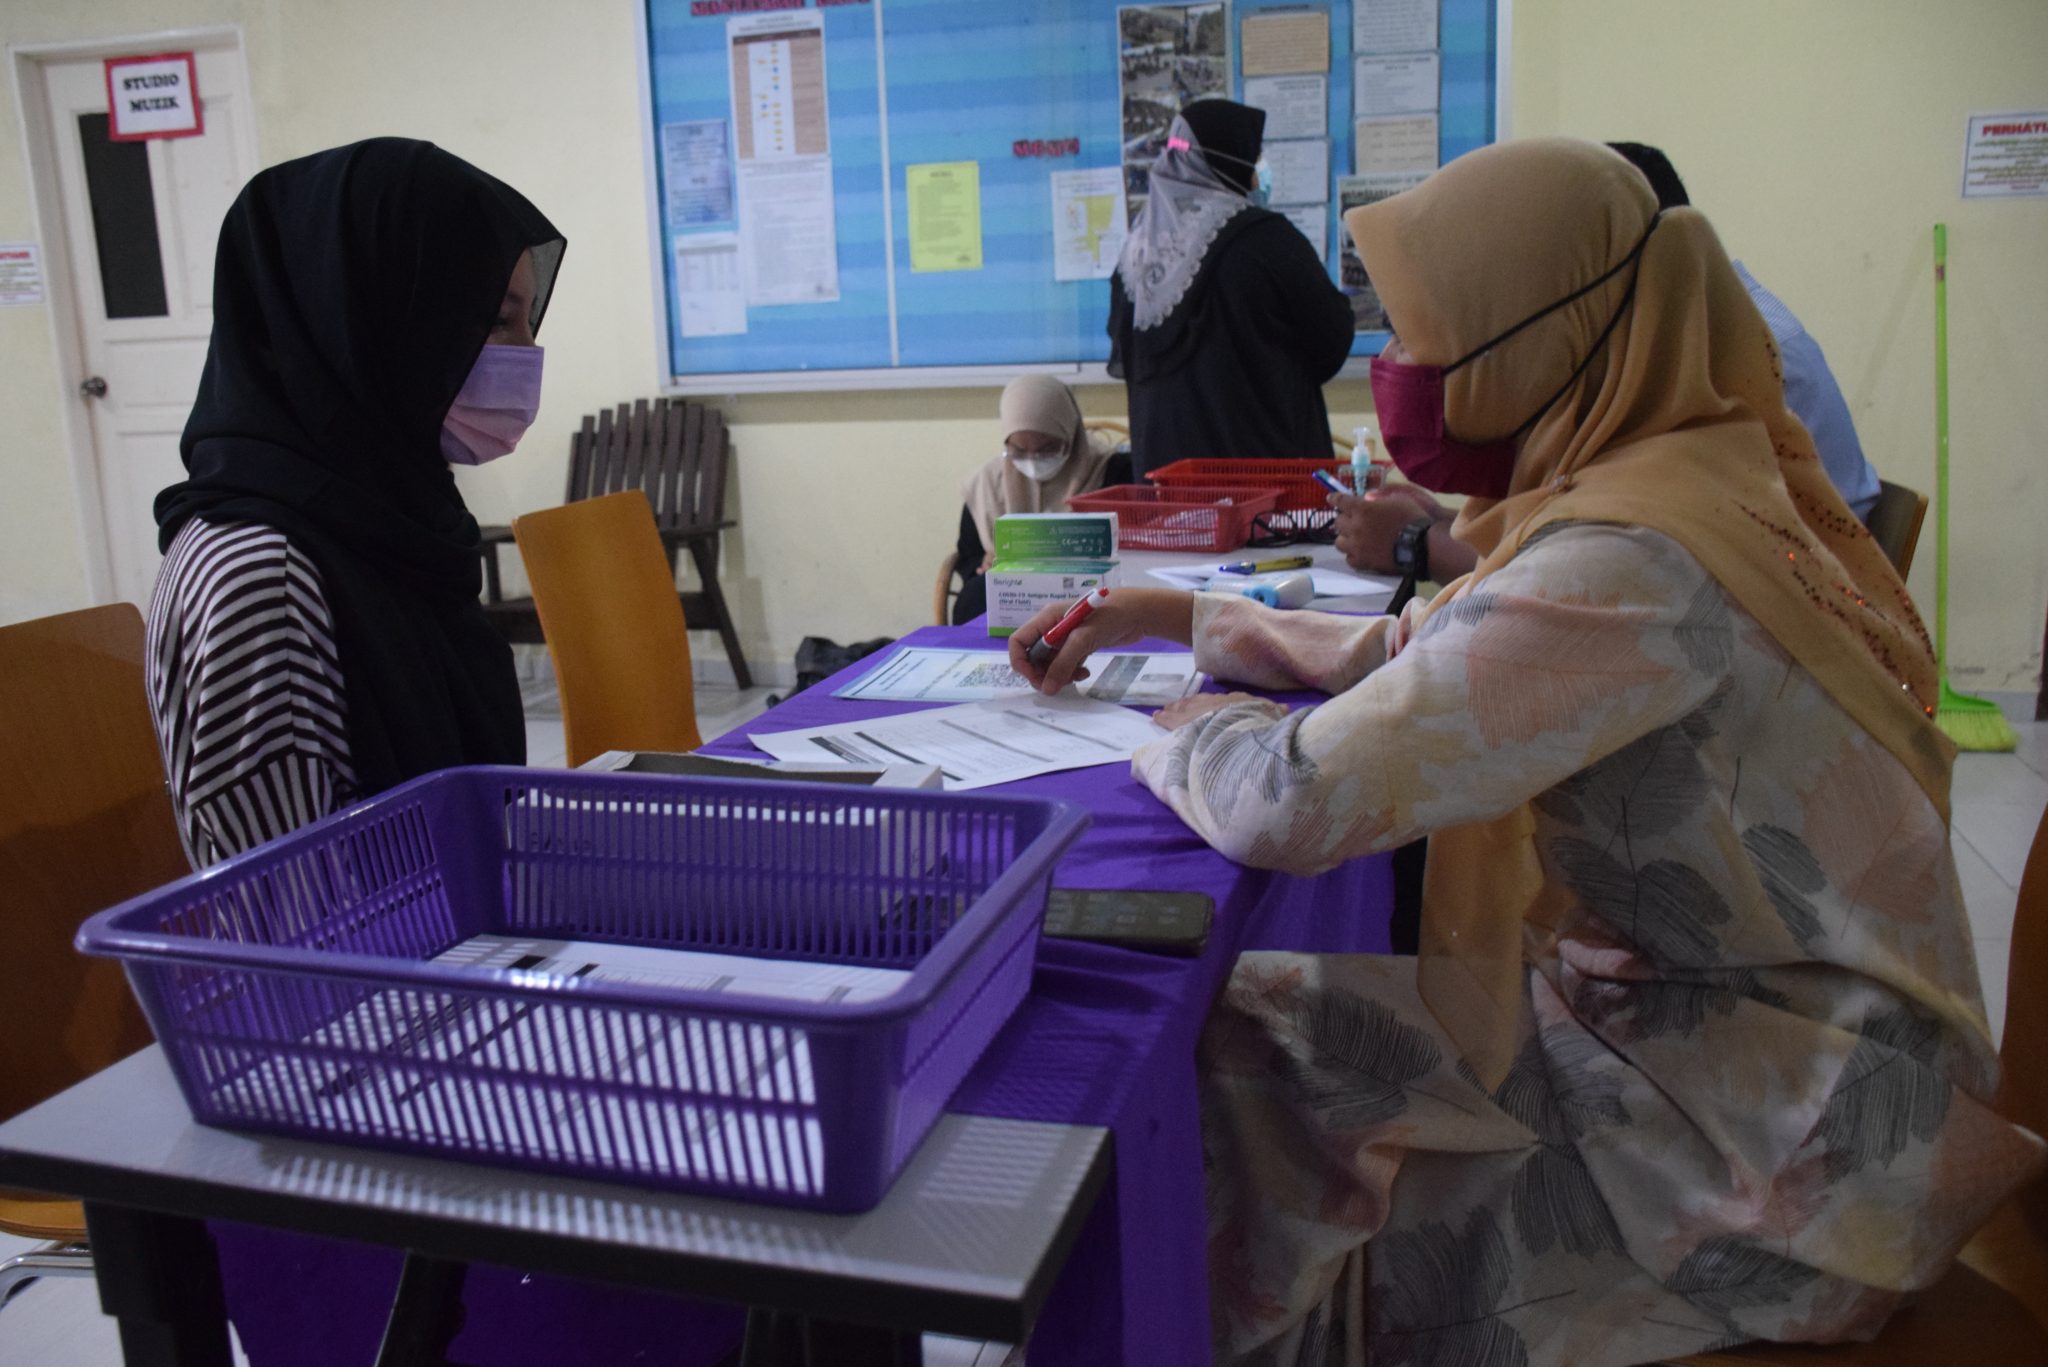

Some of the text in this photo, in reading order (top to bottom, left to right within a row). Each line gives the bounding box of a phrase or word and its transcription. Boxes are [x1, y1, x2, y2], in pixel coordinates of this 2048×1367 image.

[124, 74, 179, 90] STUDIO
[130, 97, 180, 112] MUZIK
[1982, 122, 2048, 136] PERHATI
